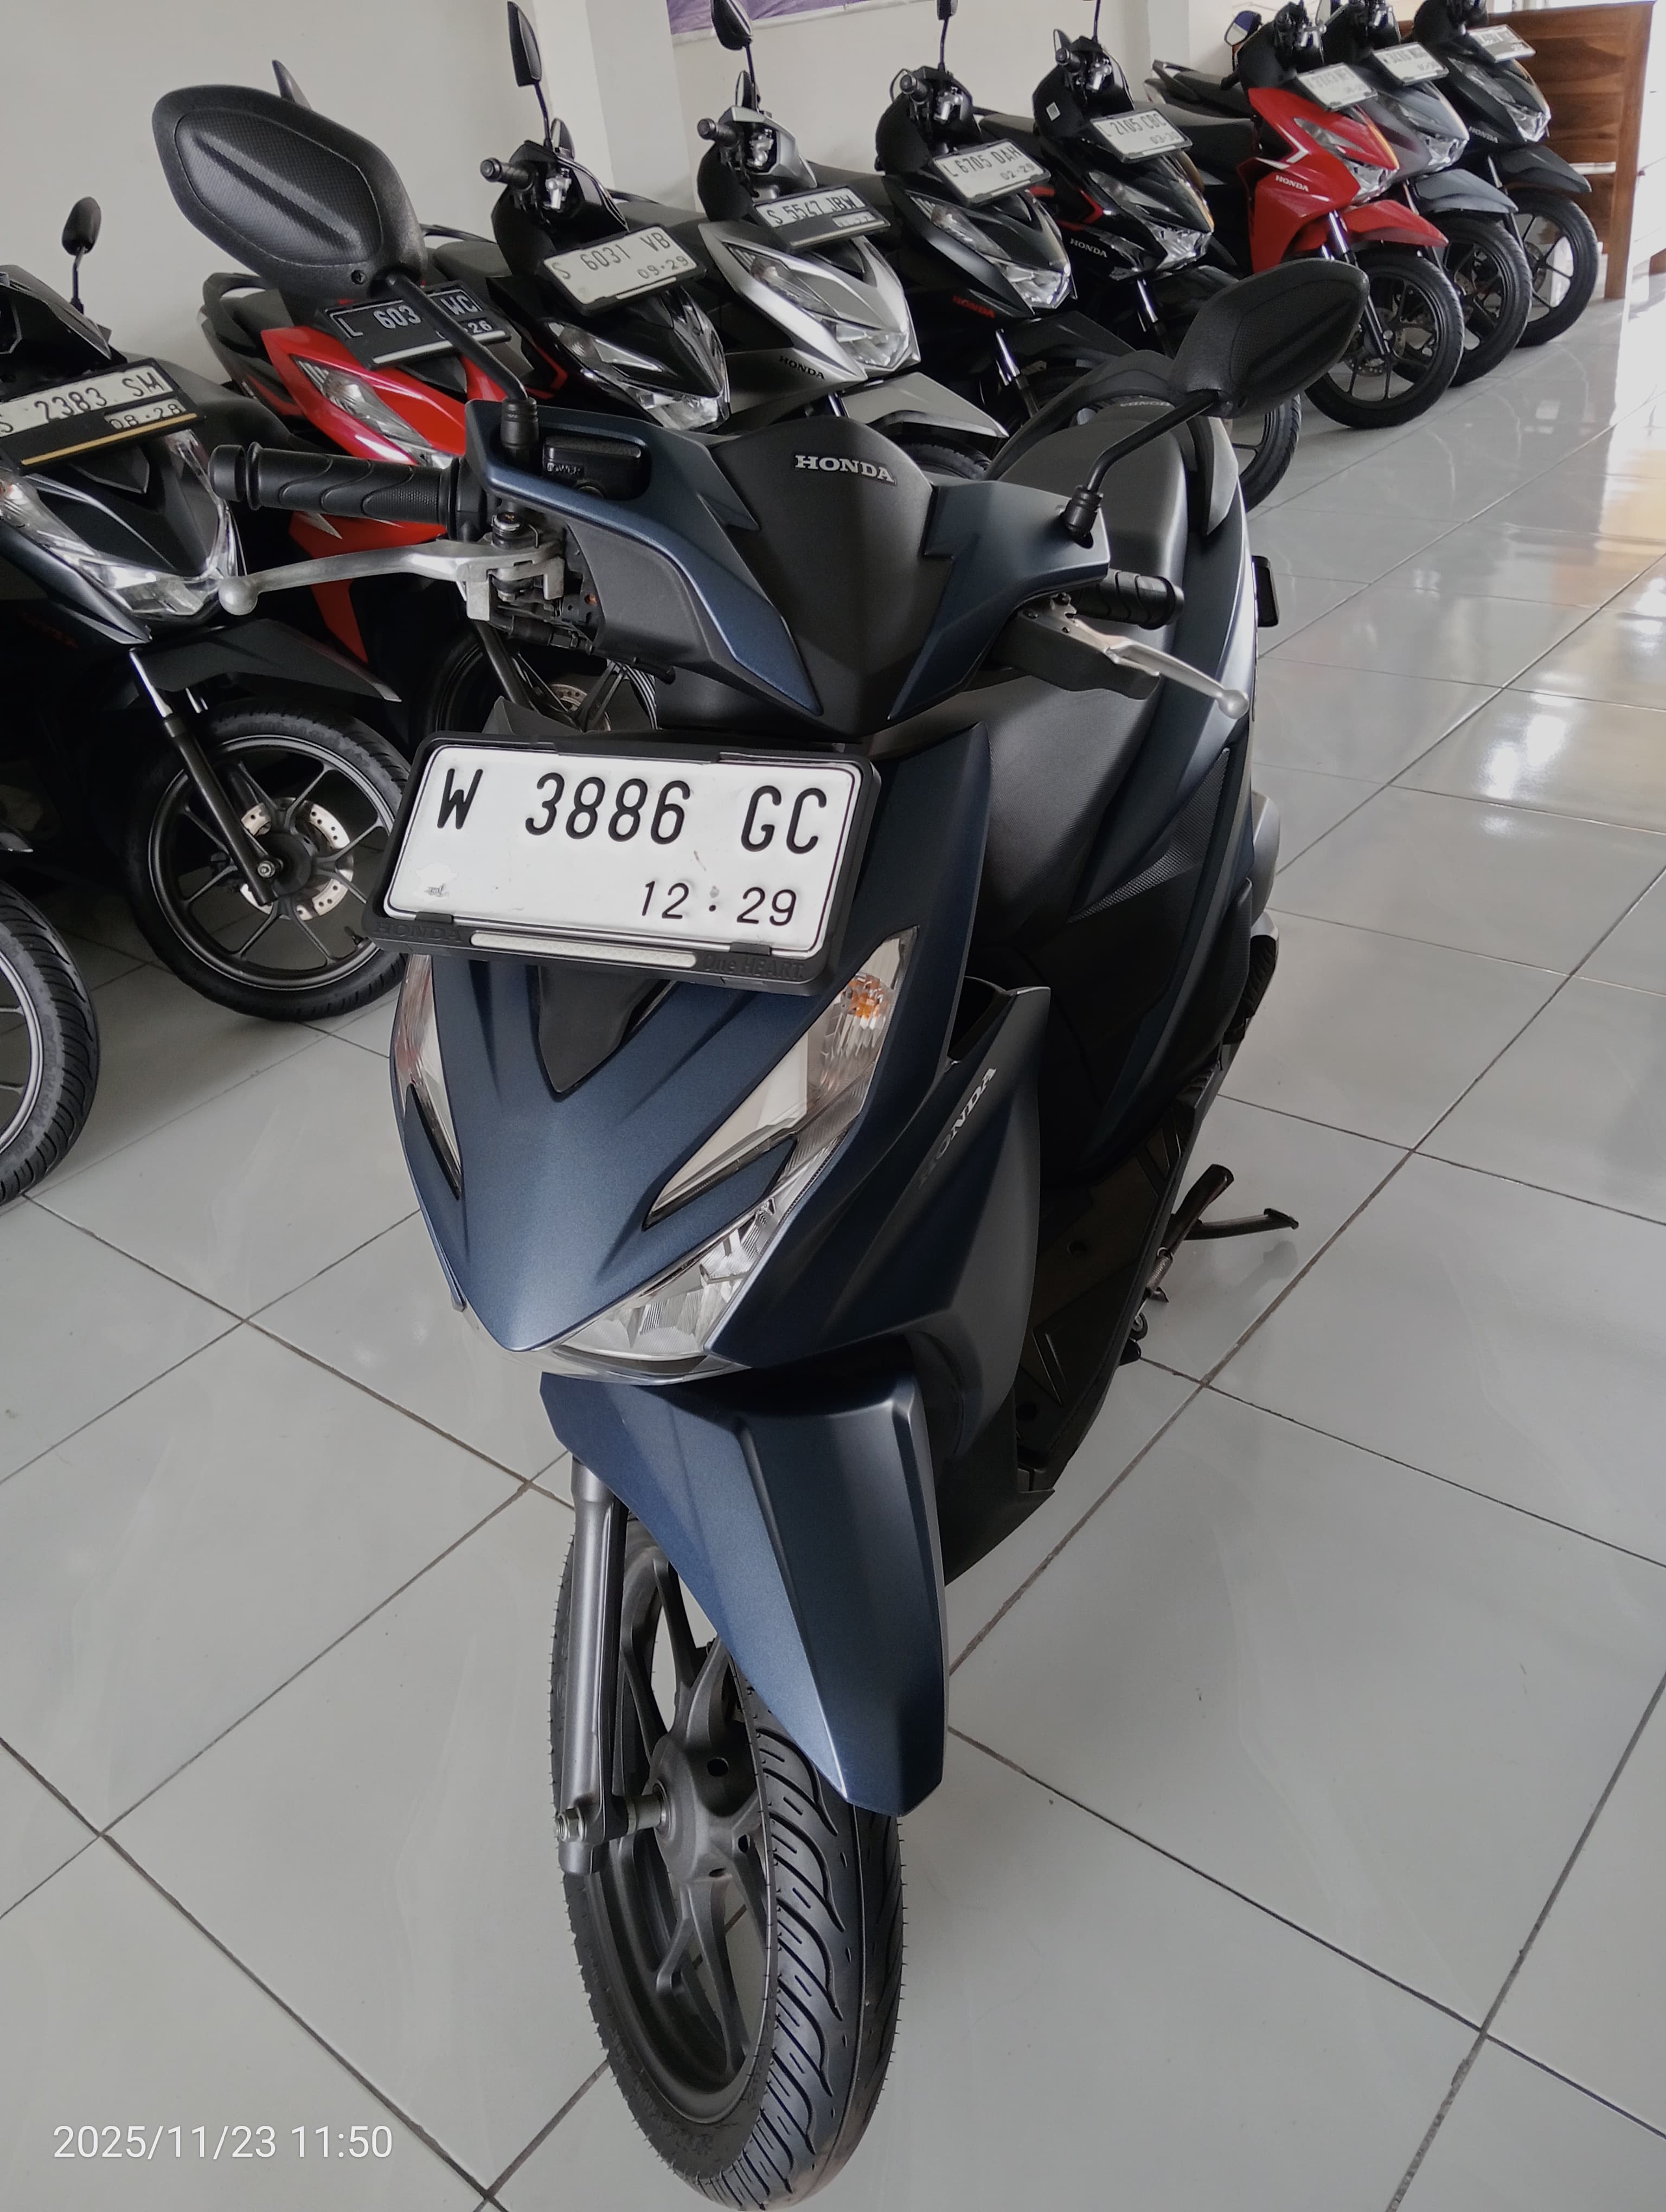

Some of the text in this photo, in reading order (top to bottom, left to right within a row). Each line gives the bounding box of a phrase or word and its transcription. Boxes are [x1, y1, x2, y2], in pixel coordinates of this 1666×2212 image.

[1096, 124, 1111, 137] L
[1109, 118, 1144, 136] 2105
[1469, 125, 1498, 144] HONDA
[941, 145, 1023, 177] L 6705 DAH
[1275, 175, 1310, 192] HONDA
[766, 209, 784, 225] S
[781, 200, 824, 221] 5547
[550, 232, 671, 280] S 6031 VB
[1070, 238, 1107, 258] HONDA
[338, 317, 364, 337] L
[440, 295, 479, 316] WC
[779, 355, 825, 381] HONDA
[34, 387, 107, 421] 2383
[121, 372, 165, 397] SM
[794, 454, 897, 484] HONDA
[436, 767, 828, 855] W 3886 GC
[373, 922, 463, 943] HONDA
[703, 955, 737, 974] One
